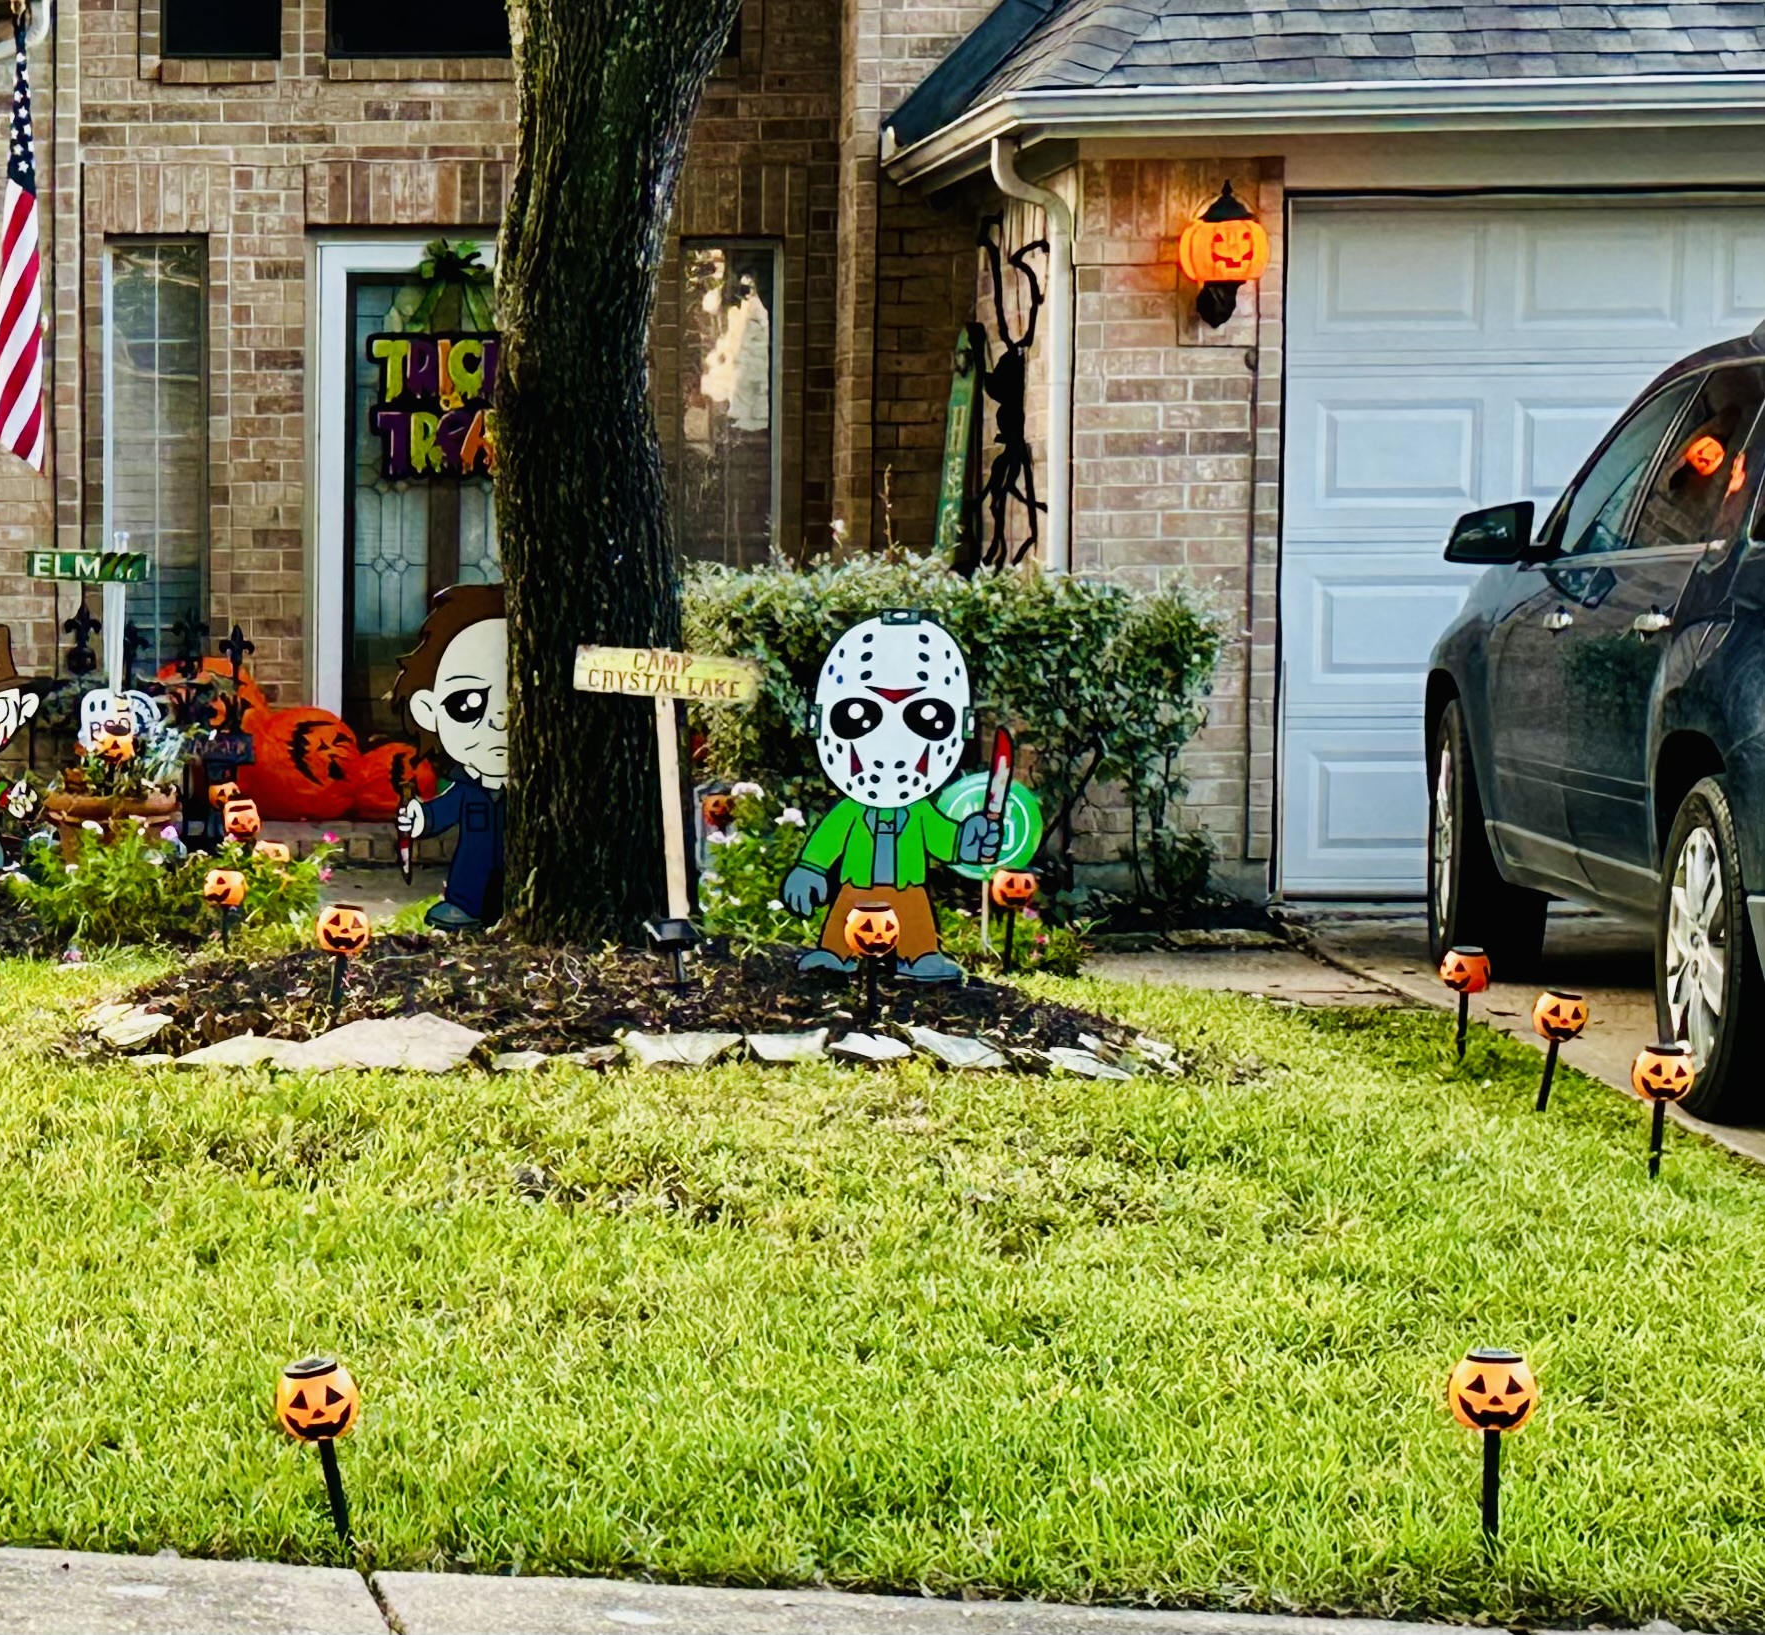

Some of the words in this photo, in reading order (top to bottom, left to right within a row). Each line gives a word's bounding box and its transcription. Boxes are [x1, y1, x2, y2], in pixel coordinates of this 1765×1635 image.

[378, 410, 498, 476] TREA
[34, 553, 100, 579] ELM
[634, 650, 694, 675] CAMP
[588, 668, 681, 694] CRYSTAL
[688, 676, 741, 699] LAKE
